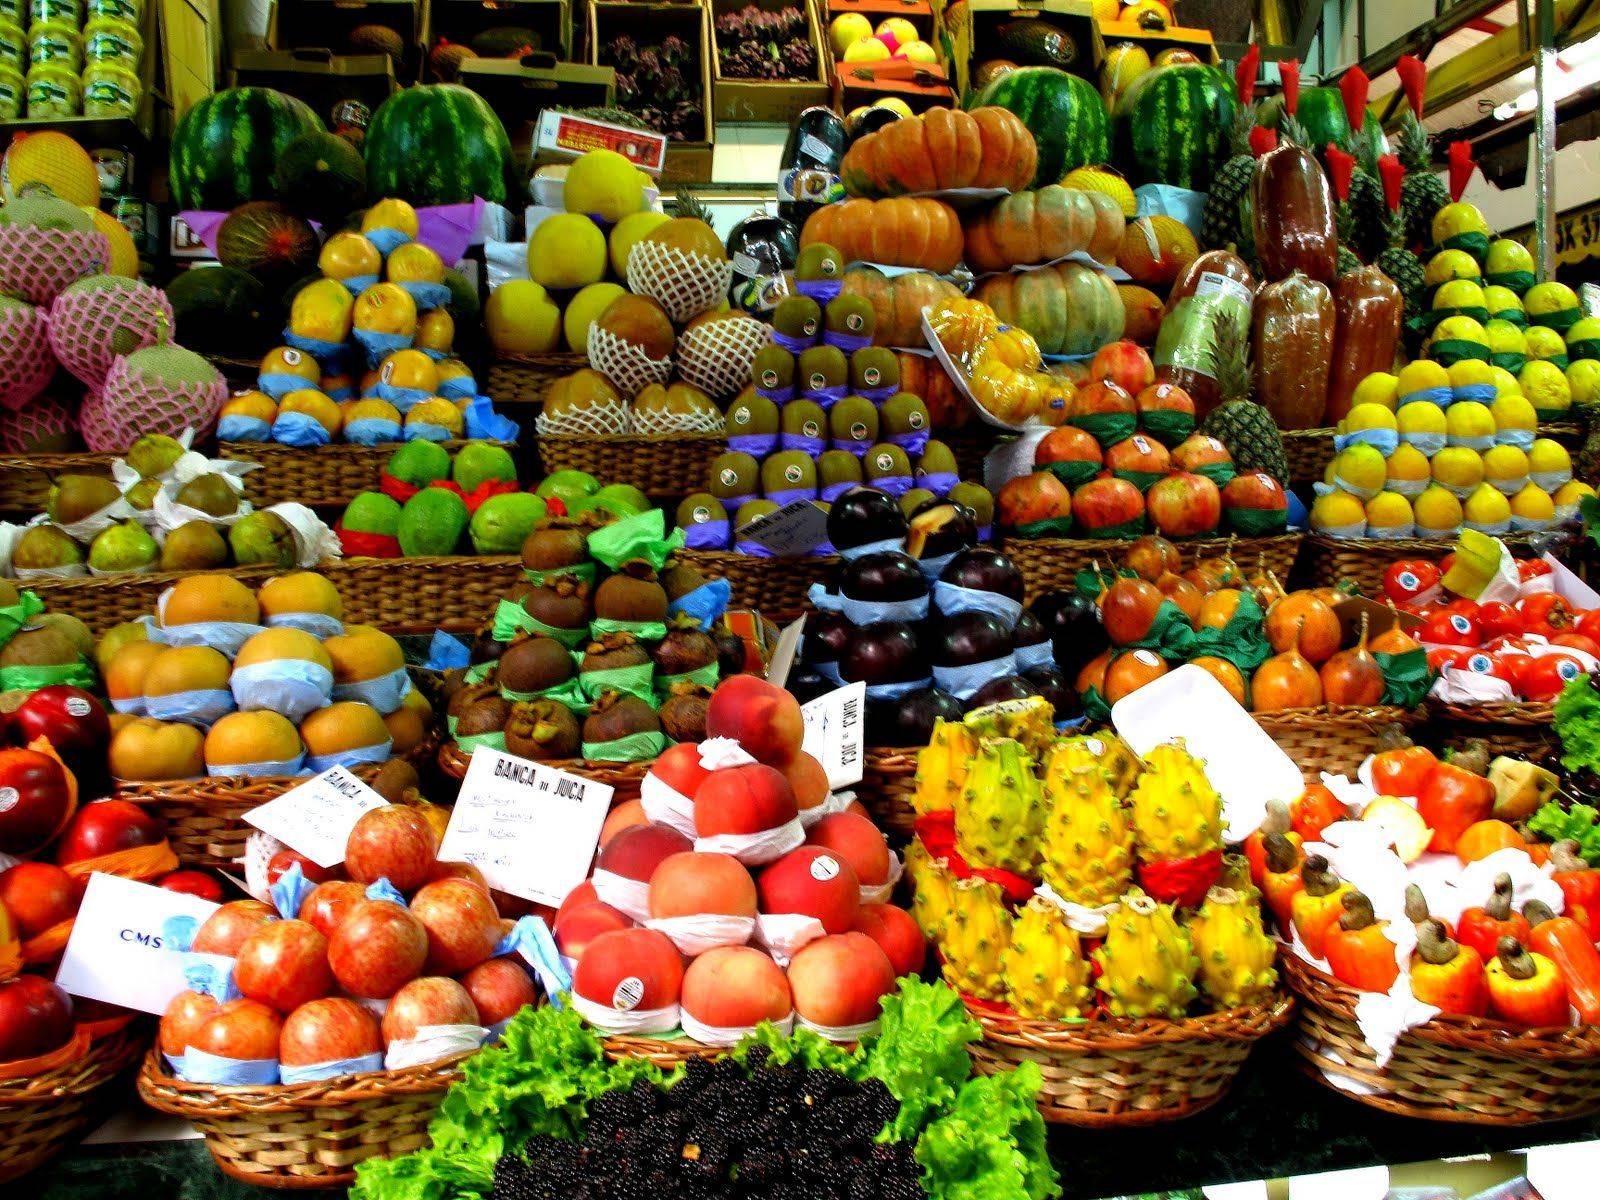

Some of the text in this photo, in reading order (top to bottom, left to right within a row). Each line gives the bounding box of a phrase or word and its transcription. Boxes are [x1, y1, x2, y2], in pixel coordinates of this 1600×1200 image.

[494, 758, 537, 788] BANCA
[553, 777, 586, 803] JUCA
[119, 928, 165, 949] CMS
